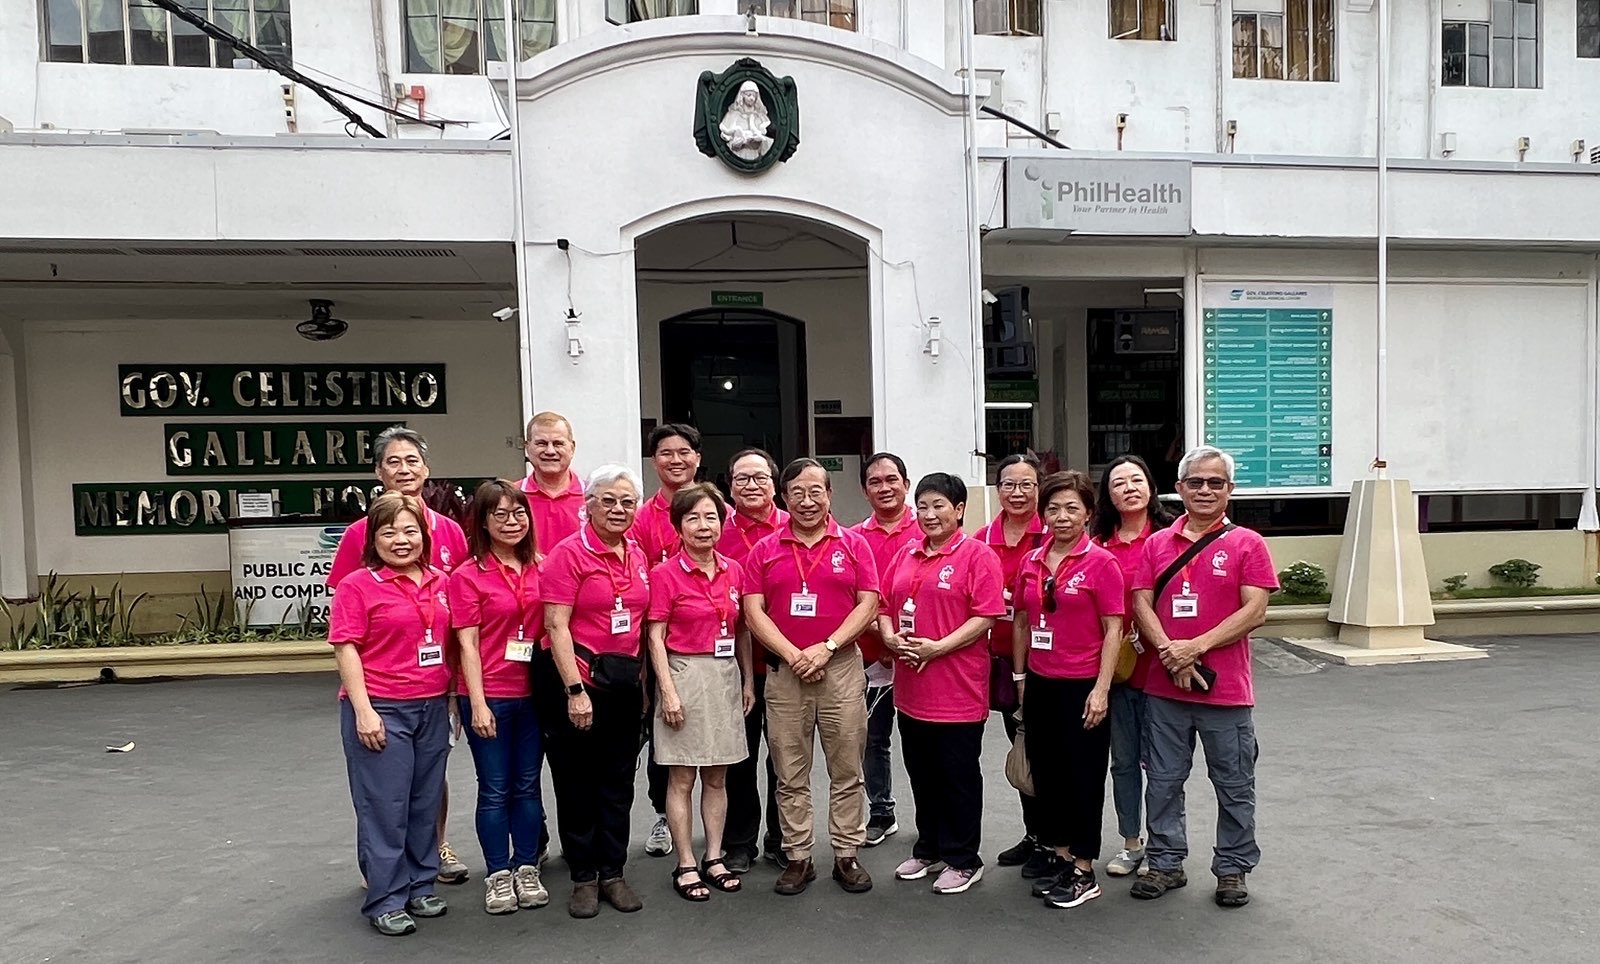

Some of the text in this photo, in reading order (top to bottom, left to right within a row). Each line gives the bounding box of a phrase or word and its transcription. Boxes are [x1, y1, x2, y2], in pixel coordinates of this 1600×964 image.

[1057, 181, 1182, 203] PhilHealth
[1073, 204, 1168, 215] Your Partner in Health
[716, 295, 758, 303] ENTRANCE
[122, 371, 438, 408] GOV. CELESTINO
[168, 430, 374, 467] GALLARE
[79, 488, 281, 526] MEMORIL
[243, 563, 306, 578] PUBLIC
[235, 583, 335, 599] AND COMPL
